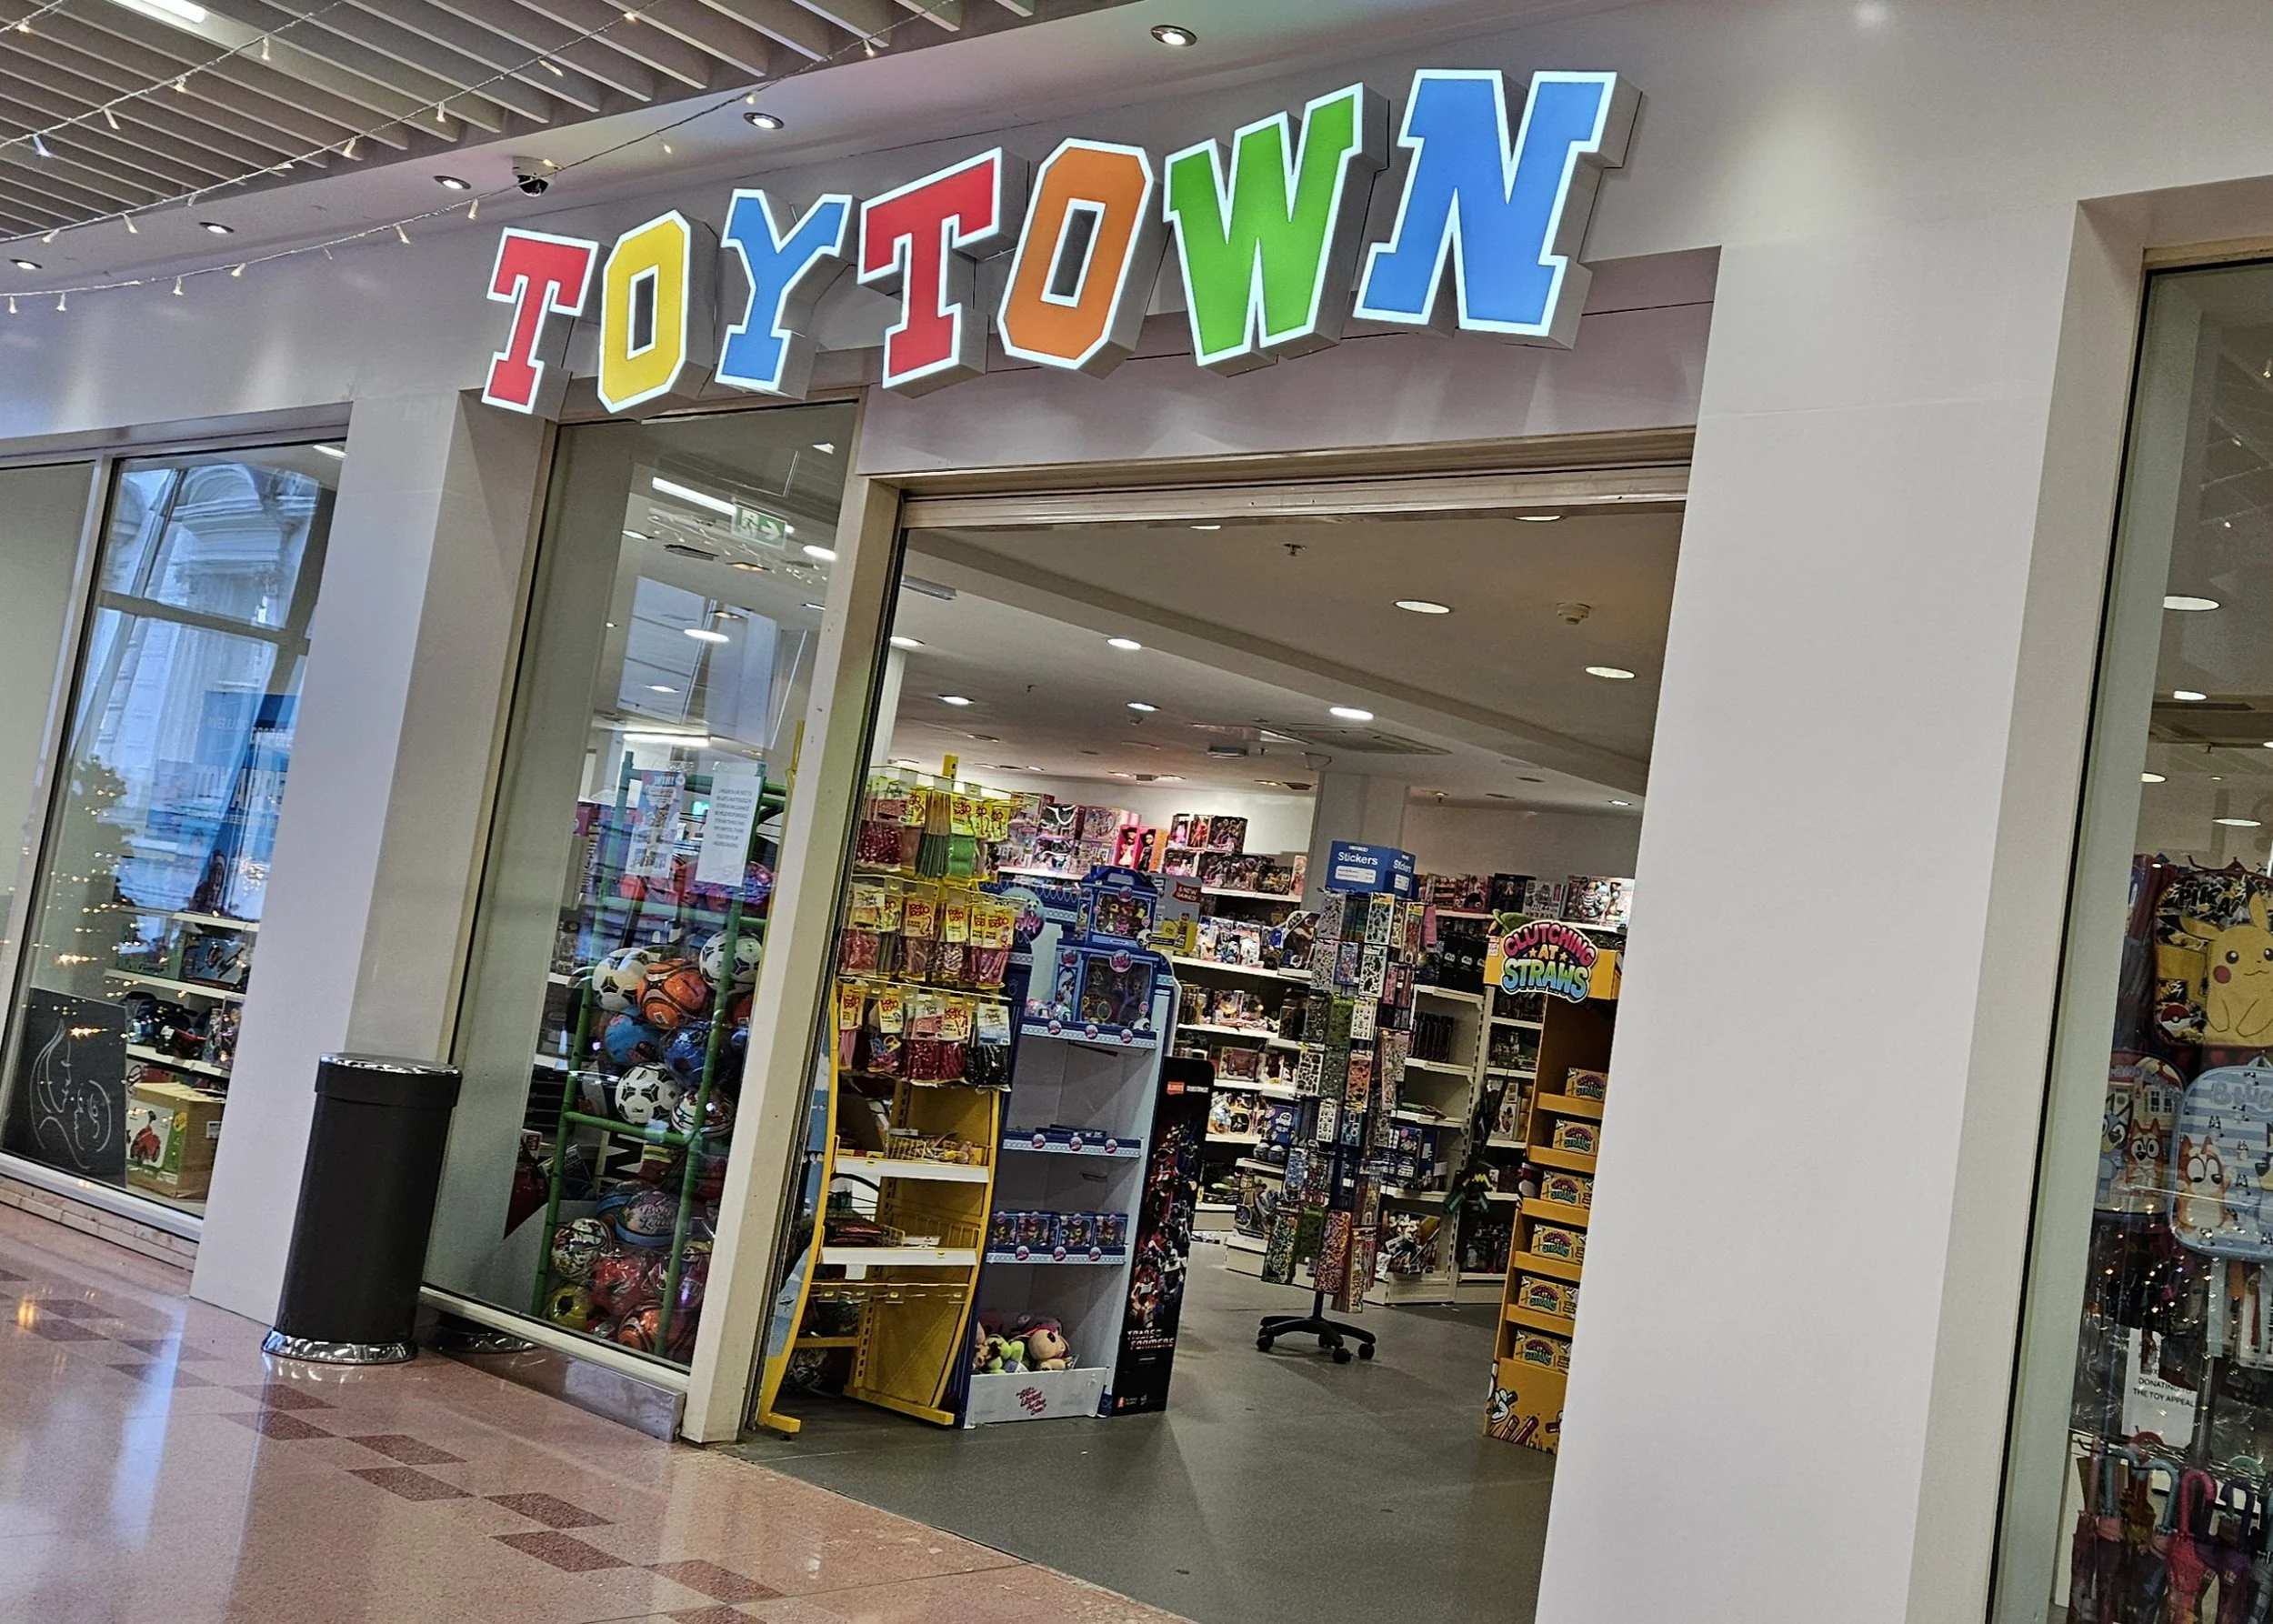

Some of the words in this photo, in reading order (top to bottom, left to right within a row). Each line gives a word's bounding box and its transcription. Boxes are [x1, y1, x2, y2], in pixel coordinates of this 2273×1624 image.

[482, 69, 1617, 414] TOYTOWN
[1337, 851, 1378, 866] Stickers
[1505, 923, 1596, 967] CLUTCHING
[1537, 944, 1559, 960] AT
[1502, 958, 1588, 998] STRAWS
[2133, 1388, 2148, 1398] THE
[2149, 1391, 2164, 1400] TOY
[2166, 1395, 2196, 1408] APPEAL
